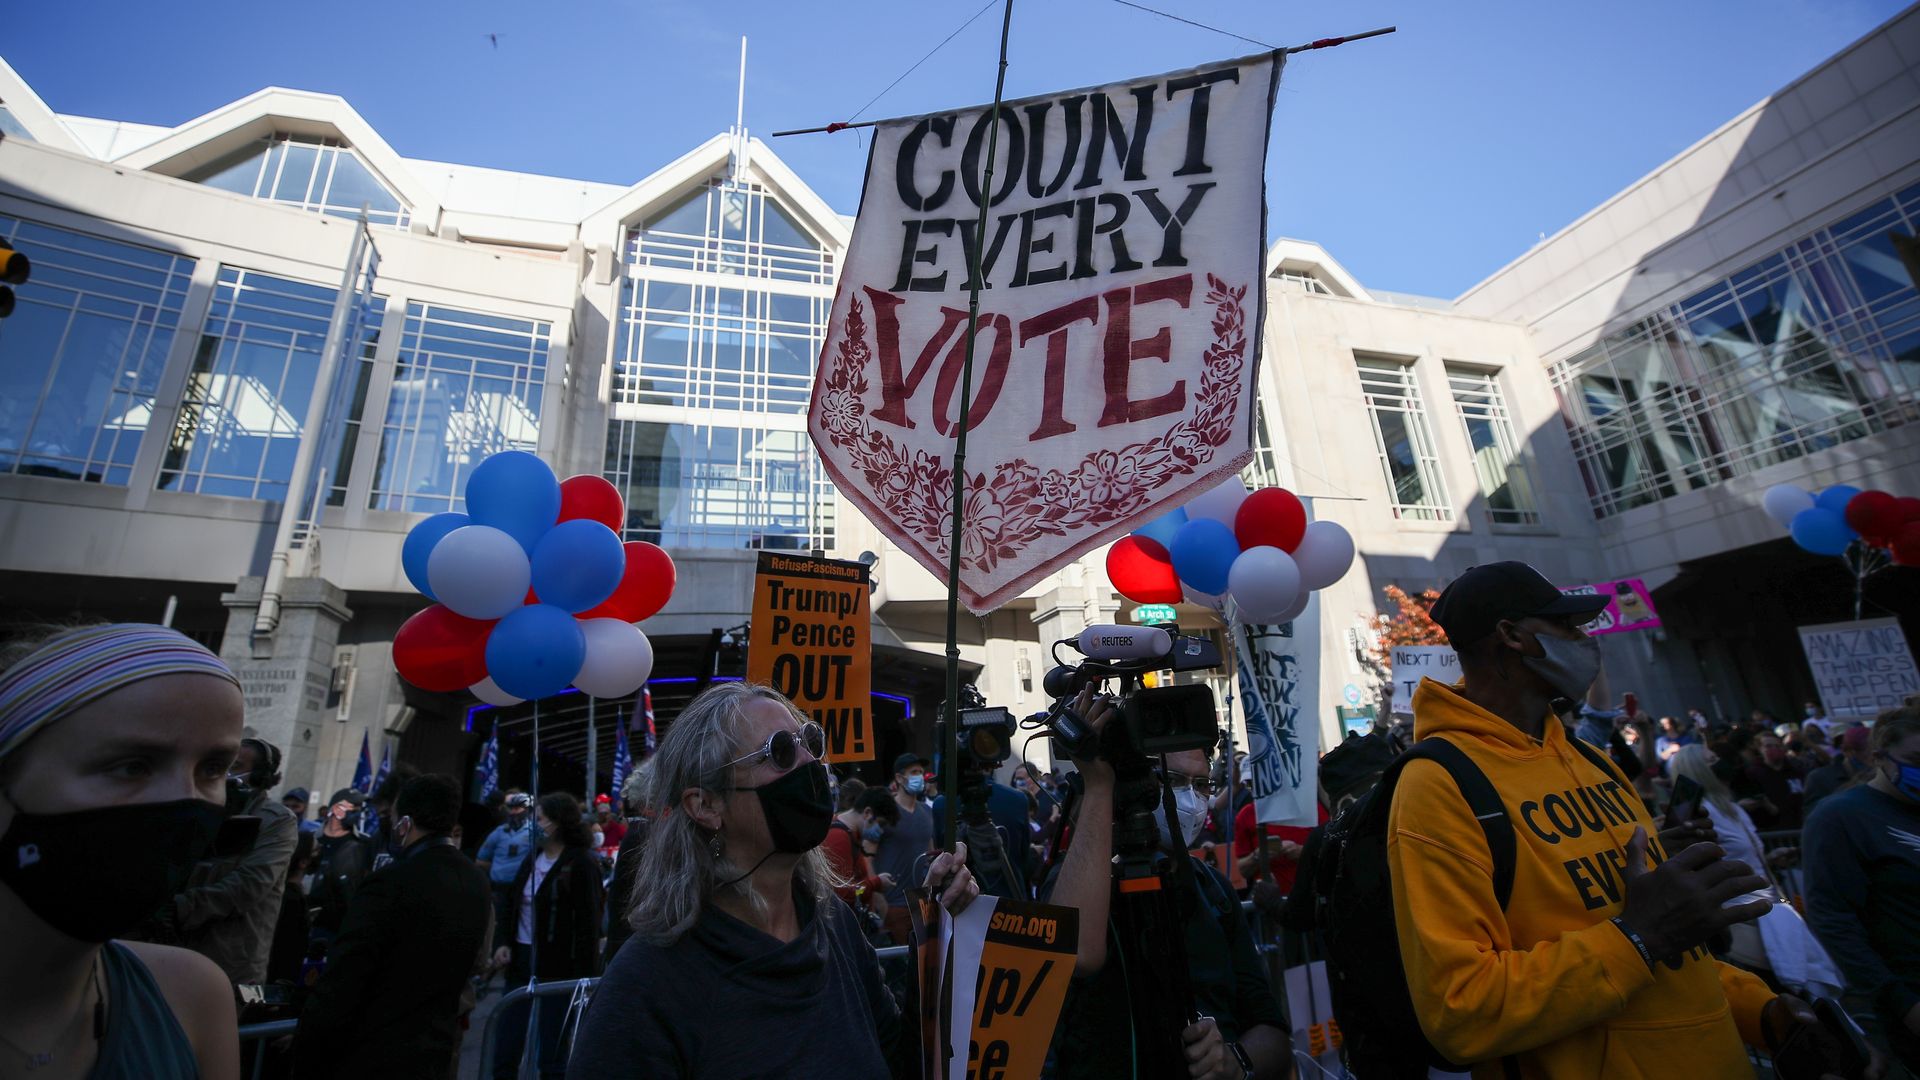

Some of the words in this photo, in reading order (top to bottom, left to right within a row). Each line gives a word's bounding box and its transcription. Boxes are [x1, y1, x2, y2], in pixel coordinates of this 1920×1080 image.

[895, 68, 1240, 212] COUNT
[889, 182, 1217, 293] EVERY
[863, 273, 1194, 442] VOTE
[771, 556, 860, 580] RefuseFascism.org
[768, 580, 861, 620] Trump/
[771, 615, 856, 648] Pence
[1101, 636, 1133, 646] REUTERS
[1808, 627, 1905, 658] AMAZING
[1396, 652, 1432, 666] NEXT
[1814, 655, 1912, 675] THINGS
[771, 653, 852, 702] OUT
[1820, 673, 1919, 696] HAPPEN
[1827, 693, 1911, 717] HER
[1520, 780, 1638, 844] COUNT
